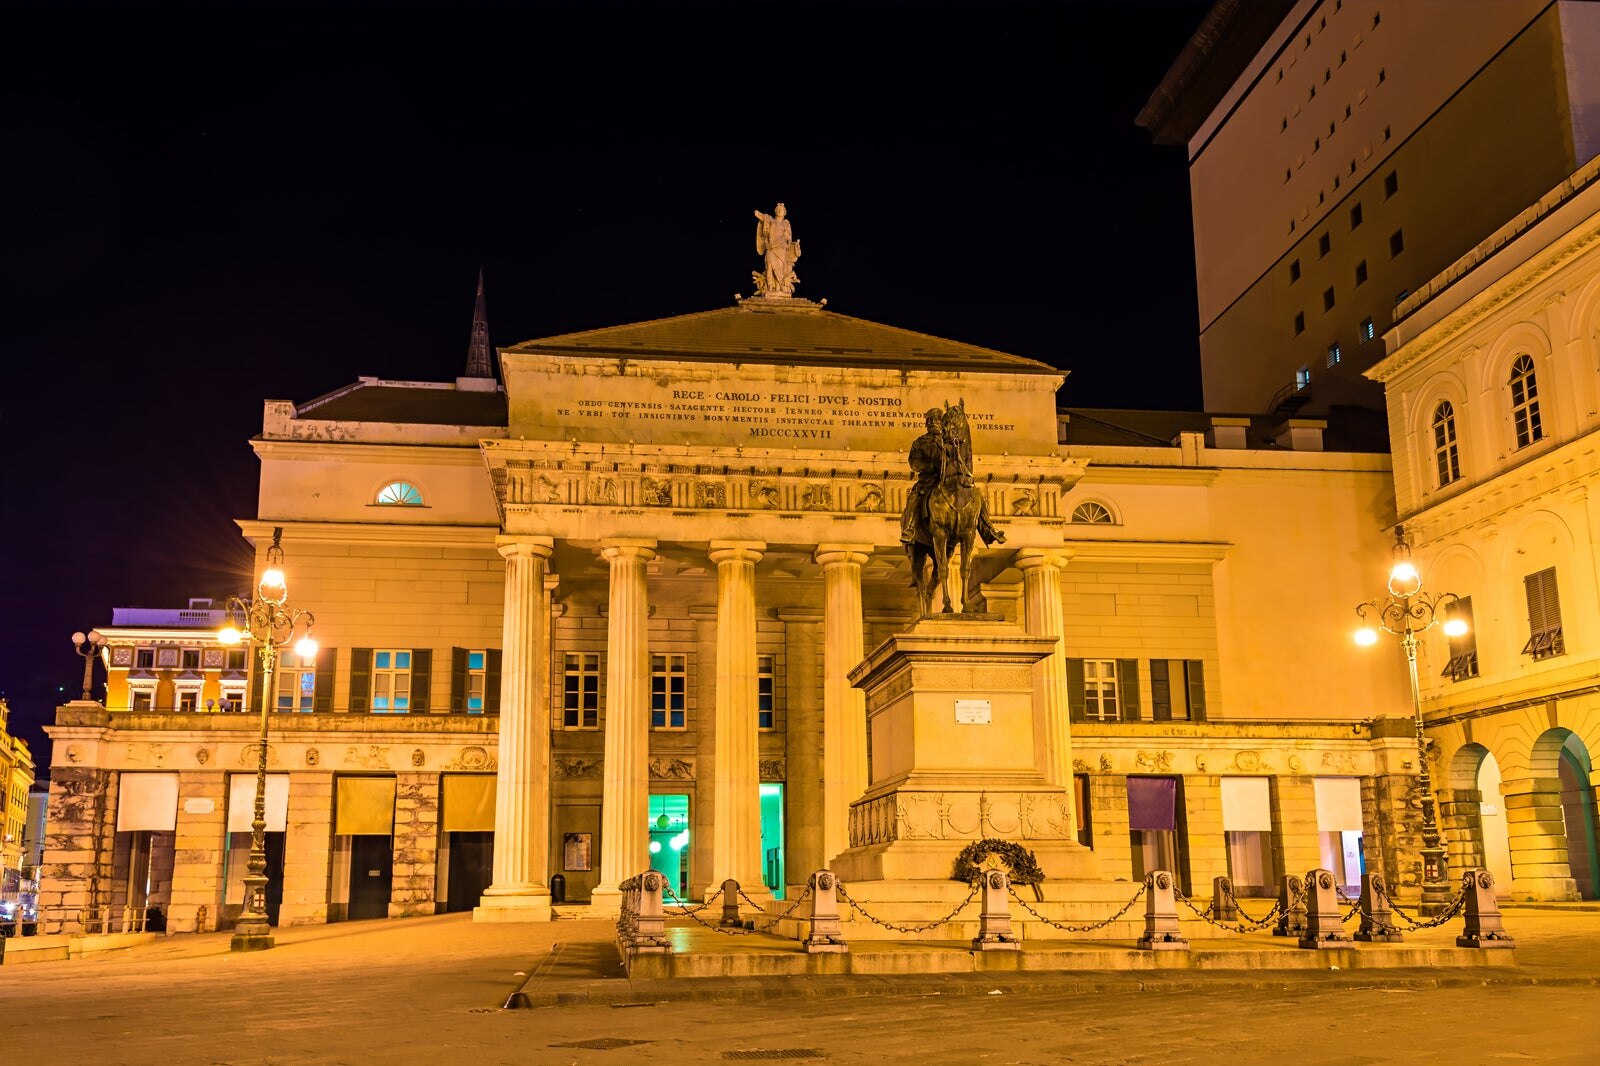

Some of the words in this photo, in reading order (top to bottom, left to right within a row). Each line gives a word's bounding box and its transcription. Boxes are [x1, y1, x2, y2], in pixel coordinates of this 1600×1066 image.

[673, 390, 704, 400] REGE
[715, 392, 760, 402] CAROLO
[770, 393, 809, 404] FELICI
[818, 395, 850, 405] DVCE
[858, 397, 902, 407] NOSTRO
[608, 401, 662, 410] GENVENSIS
[670, 403, 725, 412] SATAGENTE
[733, 406, 776, 414] HECTORE
[639, 412, 696, 421] INSIGNIBVS
[703, 414, 769, 423] MONVMENTIS
[776, 417, 834, 426] INSTRVCTAE
[842, 419, 895, 428] THEATRVM
[977, 423, 1015, 431] DEESSET
[750, 427, 831, 439] MDCCCXXVII
